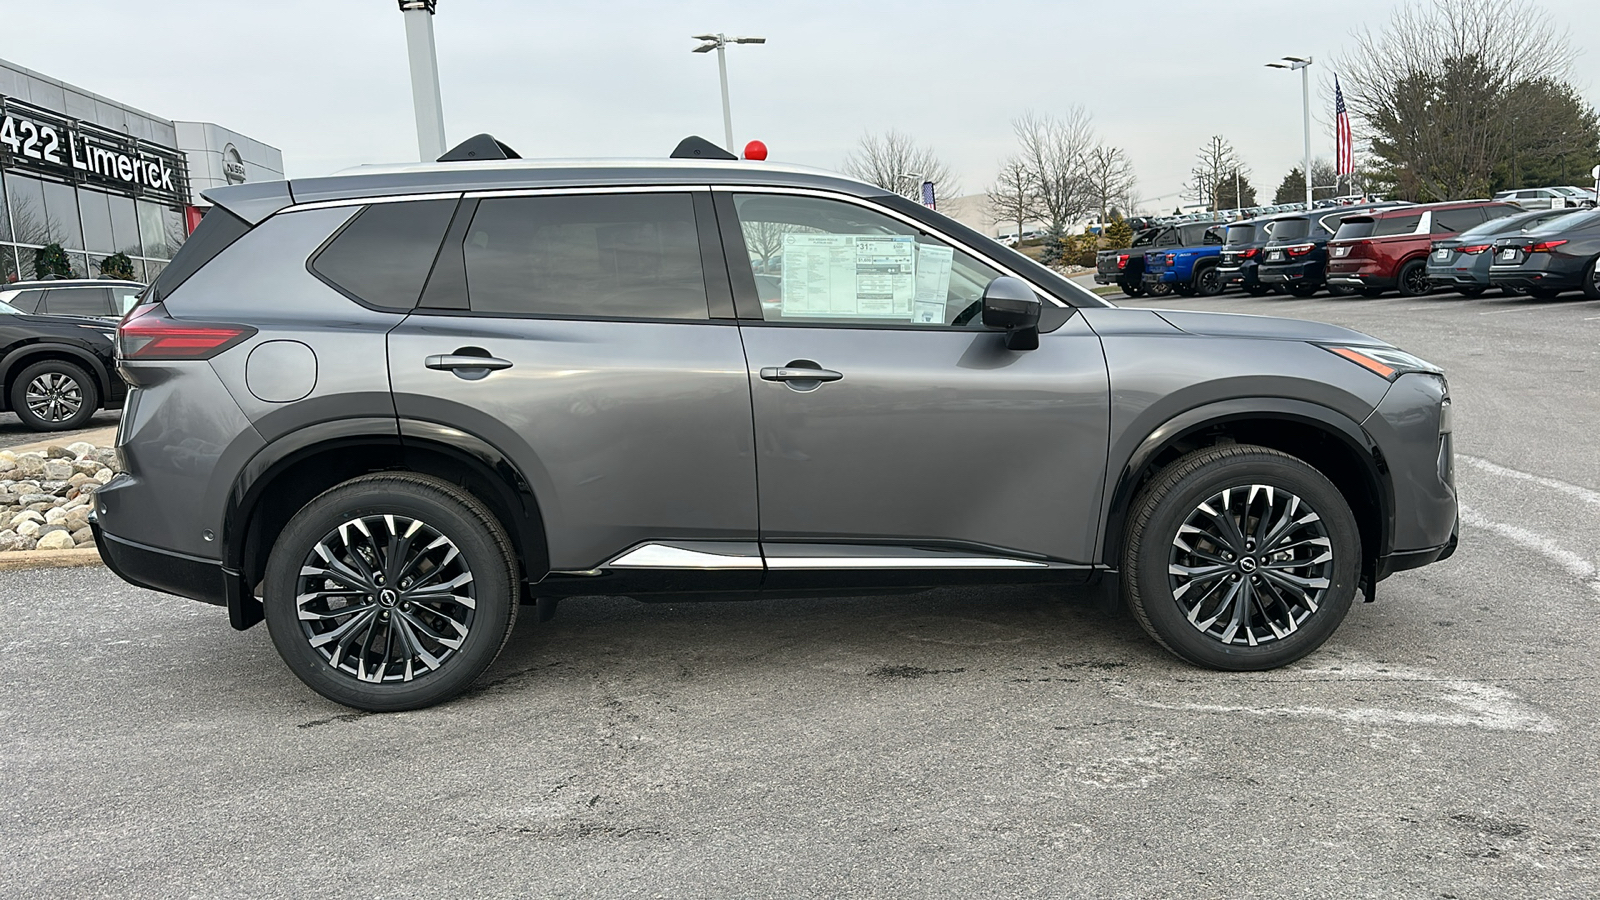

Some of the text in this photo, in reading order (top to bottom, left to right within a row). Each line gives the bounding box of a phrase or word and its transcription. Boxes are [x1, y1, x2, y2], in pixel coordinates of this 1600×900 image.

[0, 116, 174, 191] 422 Limerick
[227, 163, 246, 176] NISSA
